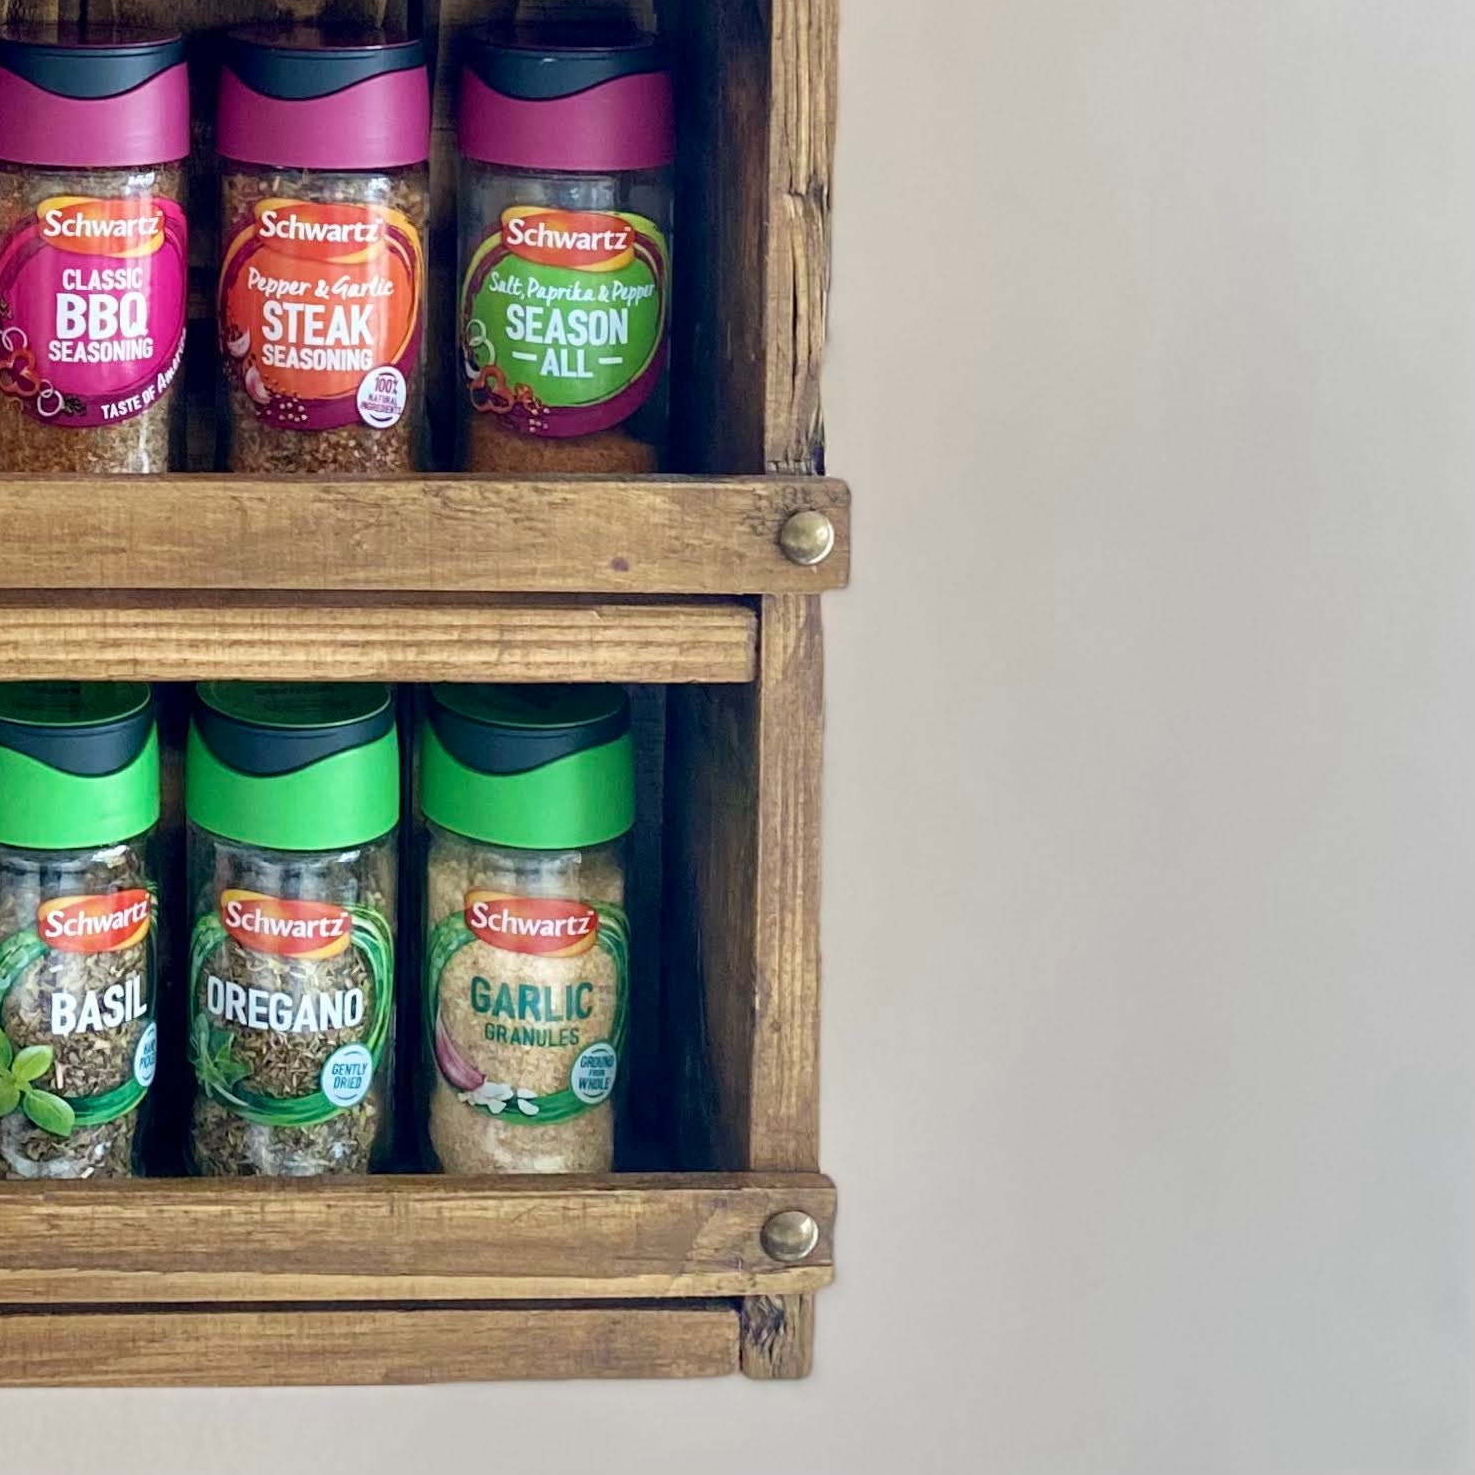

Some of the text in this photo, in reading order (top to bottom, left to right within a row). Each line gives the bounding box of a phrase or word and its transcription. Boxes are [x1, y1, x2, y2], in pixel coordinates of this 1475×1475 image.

[43, 210, 159, 238] Schwartz
[259, 210, 379, 242] Schwartz
[506, 218, 627, 251] Schwartz
[62, 267, 143, 291] CLASSIC
[248, 266, 394, 300] Pepper & Garlic
[527, 277, 594, 306] Paprika
[597, 286, 611, 302] &
[612, 281, 655, 306] Pepper
[56, 291, 148, 340] BBQ
[262, 300, 374, 346] STEAK
[506, 304, 628, 346] SEASON
[48, 337, 154, 364] SEASONING
[262, 344, 373, 371] SEASONING
[101, 394, 142, 419] TASTE
[141, 384, 156, 404] OF
[375, 376, 398, 394] 100%
[45, 900, 150, 939] Schwartz
[226, 901, 344, 938] Schwartz
[471, 901, 590, 937] Schwartz
[51, 974, 147, 1036] BASIL
[207, 976, 364, 1033] OREGANO
[470, 976, 593, 1022] GARLIC
[485, 1023, 579, 1047] GRANULES
[332, 1063, 367, 1076] GENTLY
[333, 1076, 362, 1089] DRIED
